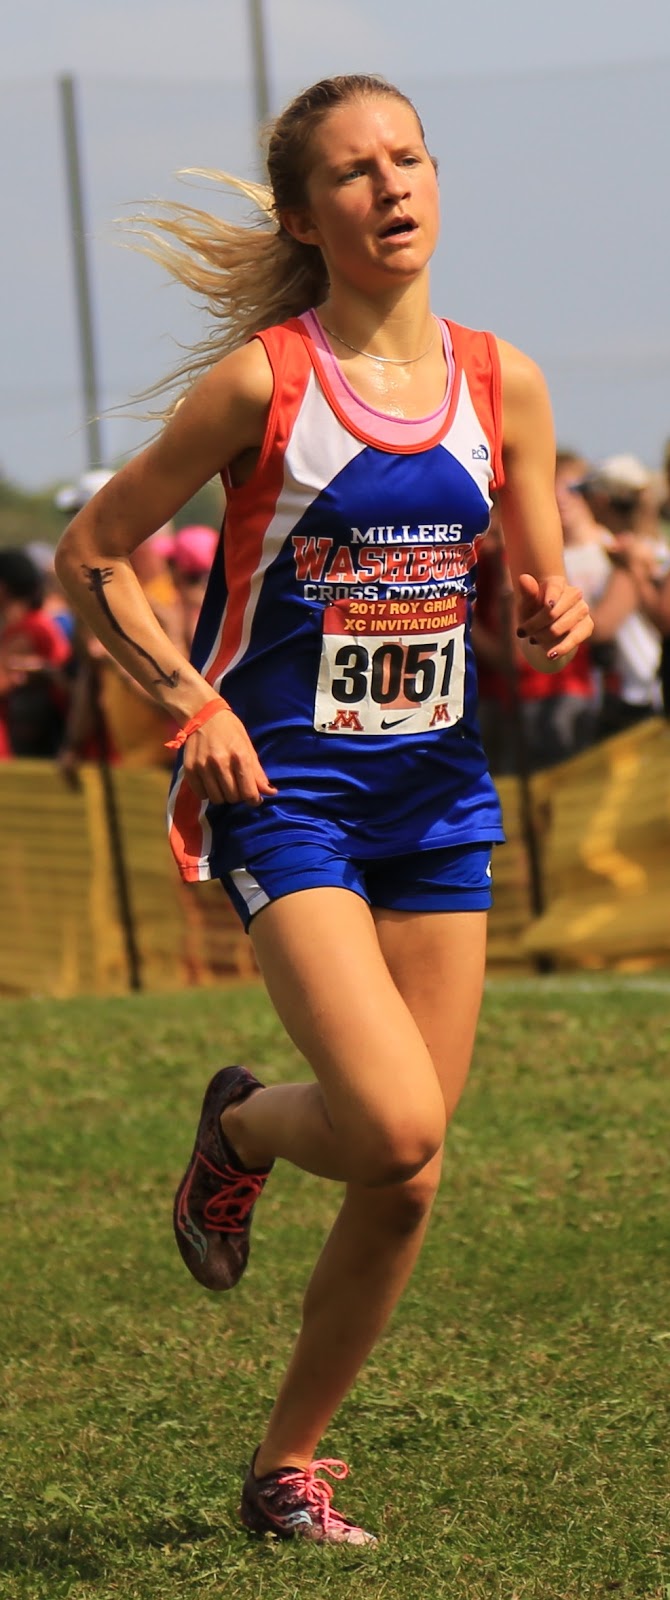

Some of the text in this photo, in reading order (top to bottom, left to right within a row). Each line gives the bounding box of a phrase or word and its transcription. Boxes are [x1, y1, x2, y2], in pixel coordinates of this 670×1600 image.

[351, 524, 463, 544] MILLERS
[303, 584, 379, 601] CROSS
[349, 596, 458, 615] 2017 ROY GRIAK
[344, 612, 458, 631] XC INVITATIONAL
[331, 638, 455, 704] 3051
